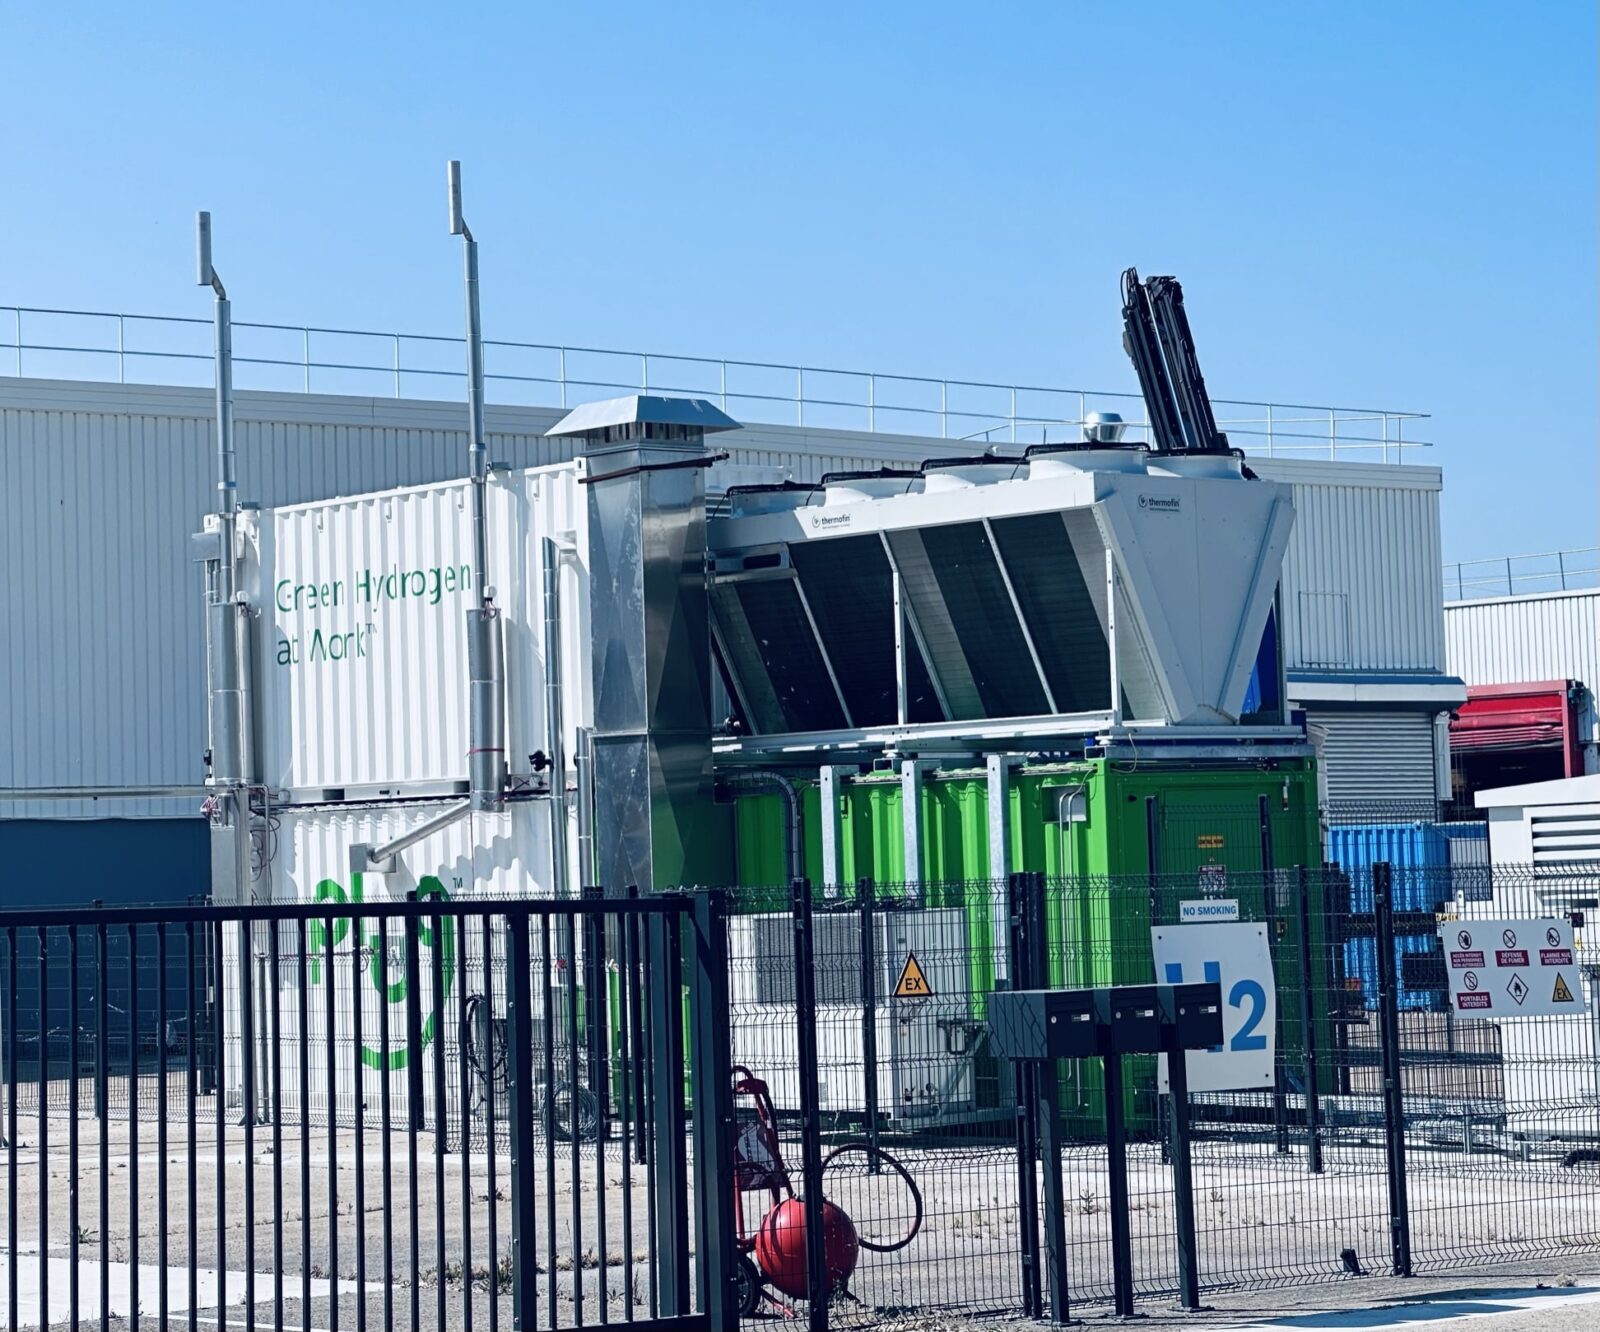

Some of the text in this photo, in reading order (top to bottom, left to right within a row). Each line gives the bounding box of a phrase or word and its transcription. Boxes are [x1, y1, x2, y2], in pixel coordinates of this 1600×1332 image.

[276, 563, 471, 612] Green Hydrogen
[277, 633, 299, 666] at
[1183, 905, 1237, 917] NO SMOKING
[905, 977, 922, 991] EX
[1557, 988, 1569, 999] EX
